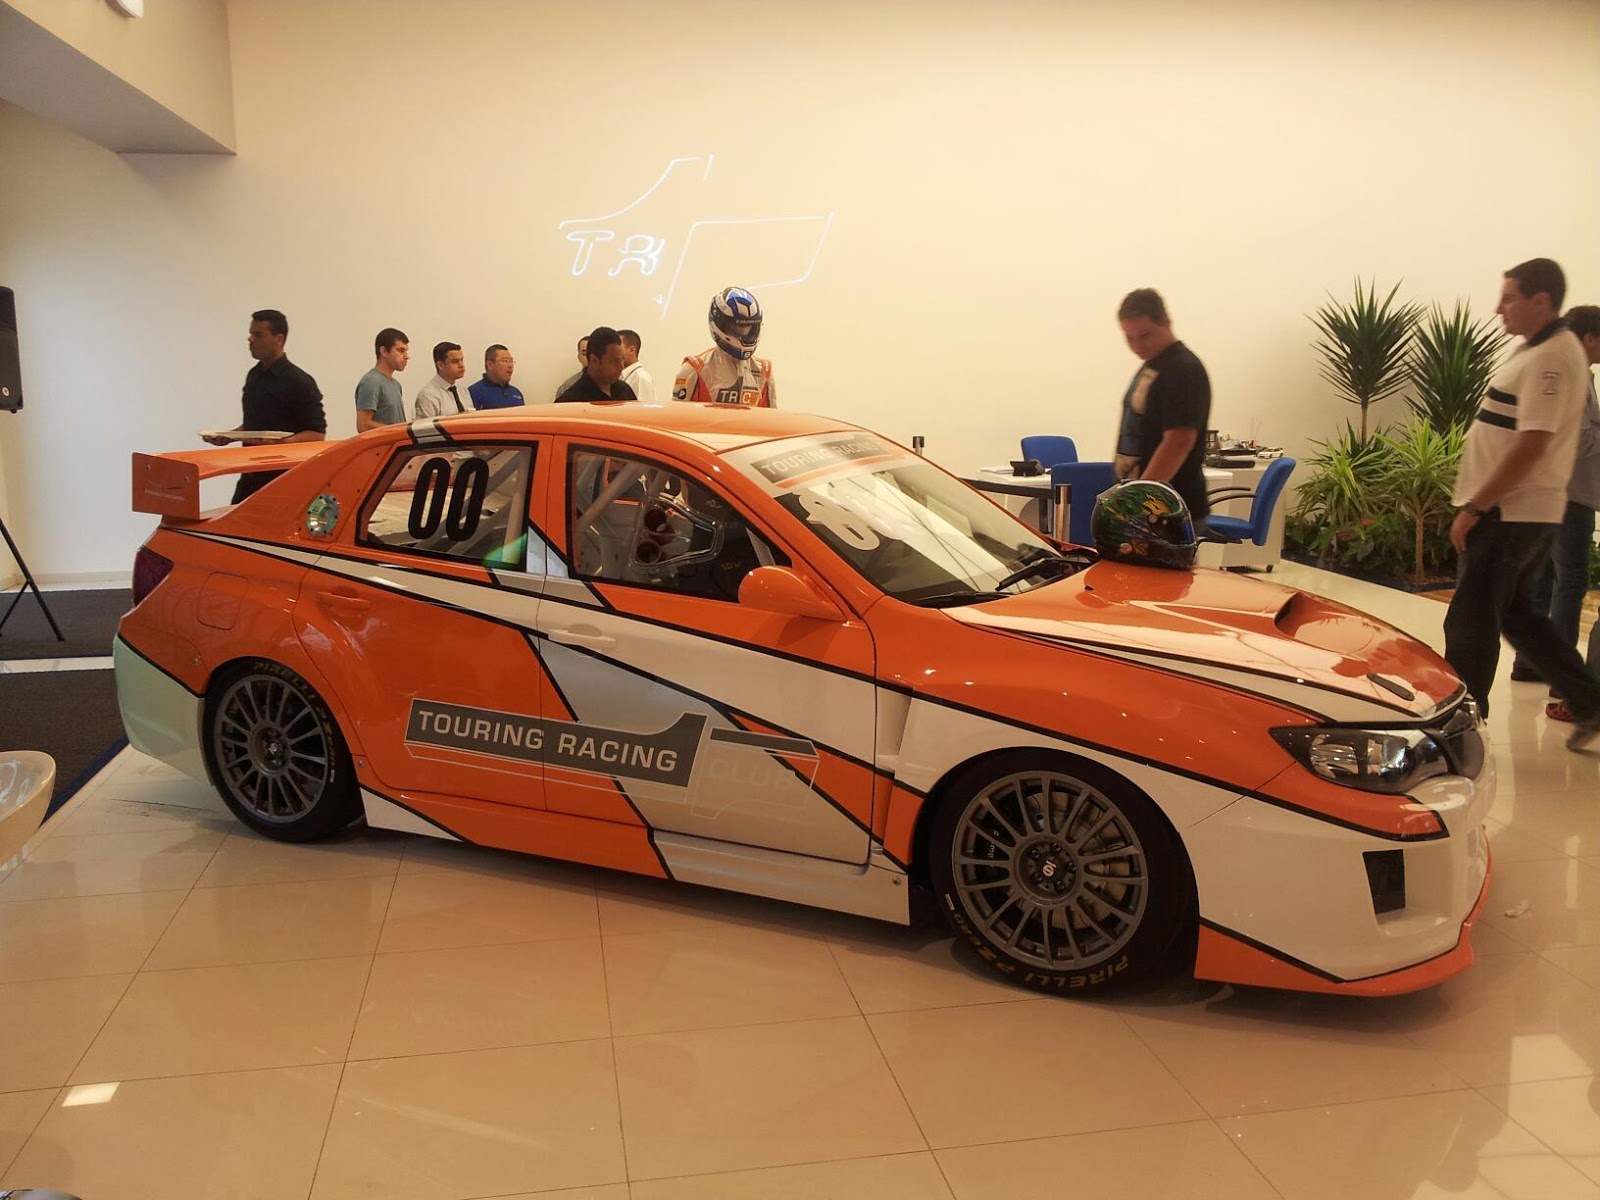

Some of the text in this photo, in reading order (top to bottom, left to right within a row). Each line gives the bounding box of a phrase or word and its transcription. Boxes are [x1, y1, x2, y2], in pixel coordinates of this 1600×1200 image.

[761, 447, 834, 475] TOURING
[407, 457, 489, 542] 00
[418, 710, 679, 772] TOURING RACING
[1023, 954, 1130, 988] PIRELLI
